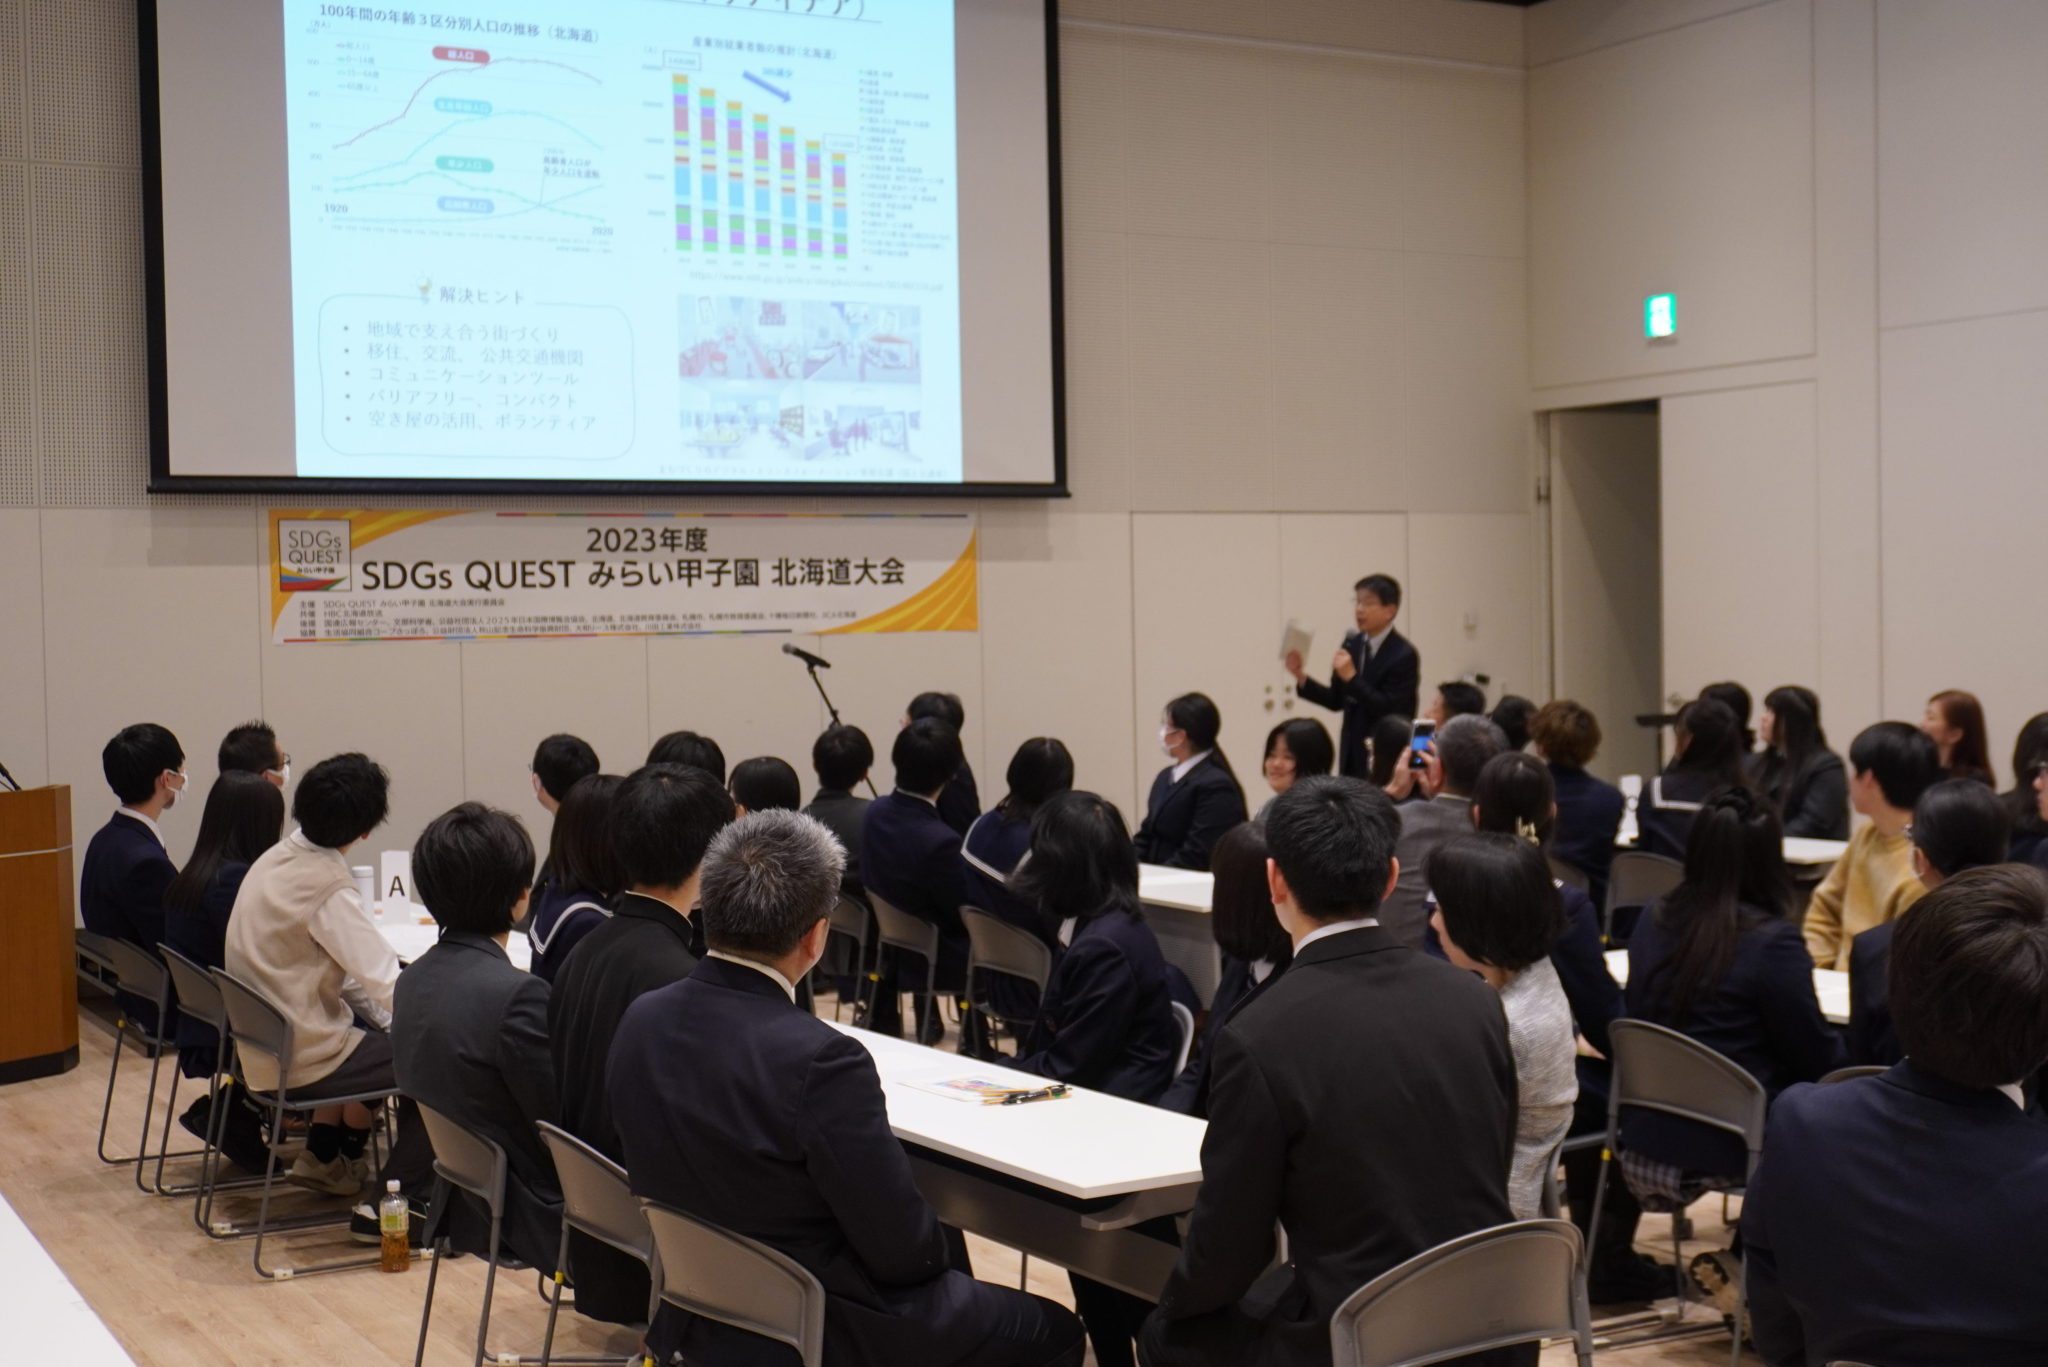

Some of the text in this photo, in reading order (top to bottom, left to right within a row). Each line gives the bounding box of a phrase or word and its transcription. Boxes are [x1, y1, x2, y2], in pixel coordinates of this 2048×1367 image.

[324, 202, 349, 214] 1920
[440, 285, 526, 306] 解決ヒント
[367, 320, 560, 343] 地域で支え合う街づくり
[368, 366, 579, 387] コミュニケーションツール
[288, 529, 342, 550] SDGs
[586, 527, 708, 553] 2023年度
[288, 549, 343, 565] QUEST
[296, 566, 336, 575] みらい甲子園
[361, 557, 906, 591] SDGs QUEST みらい甲子園 北海道大会
[323, 600, 346, 608] SDGs
[348, 600, 376, 609] QUEST
[380, 599, 426, 608] みらい甲子園
[387, 874, 405, 898] A
